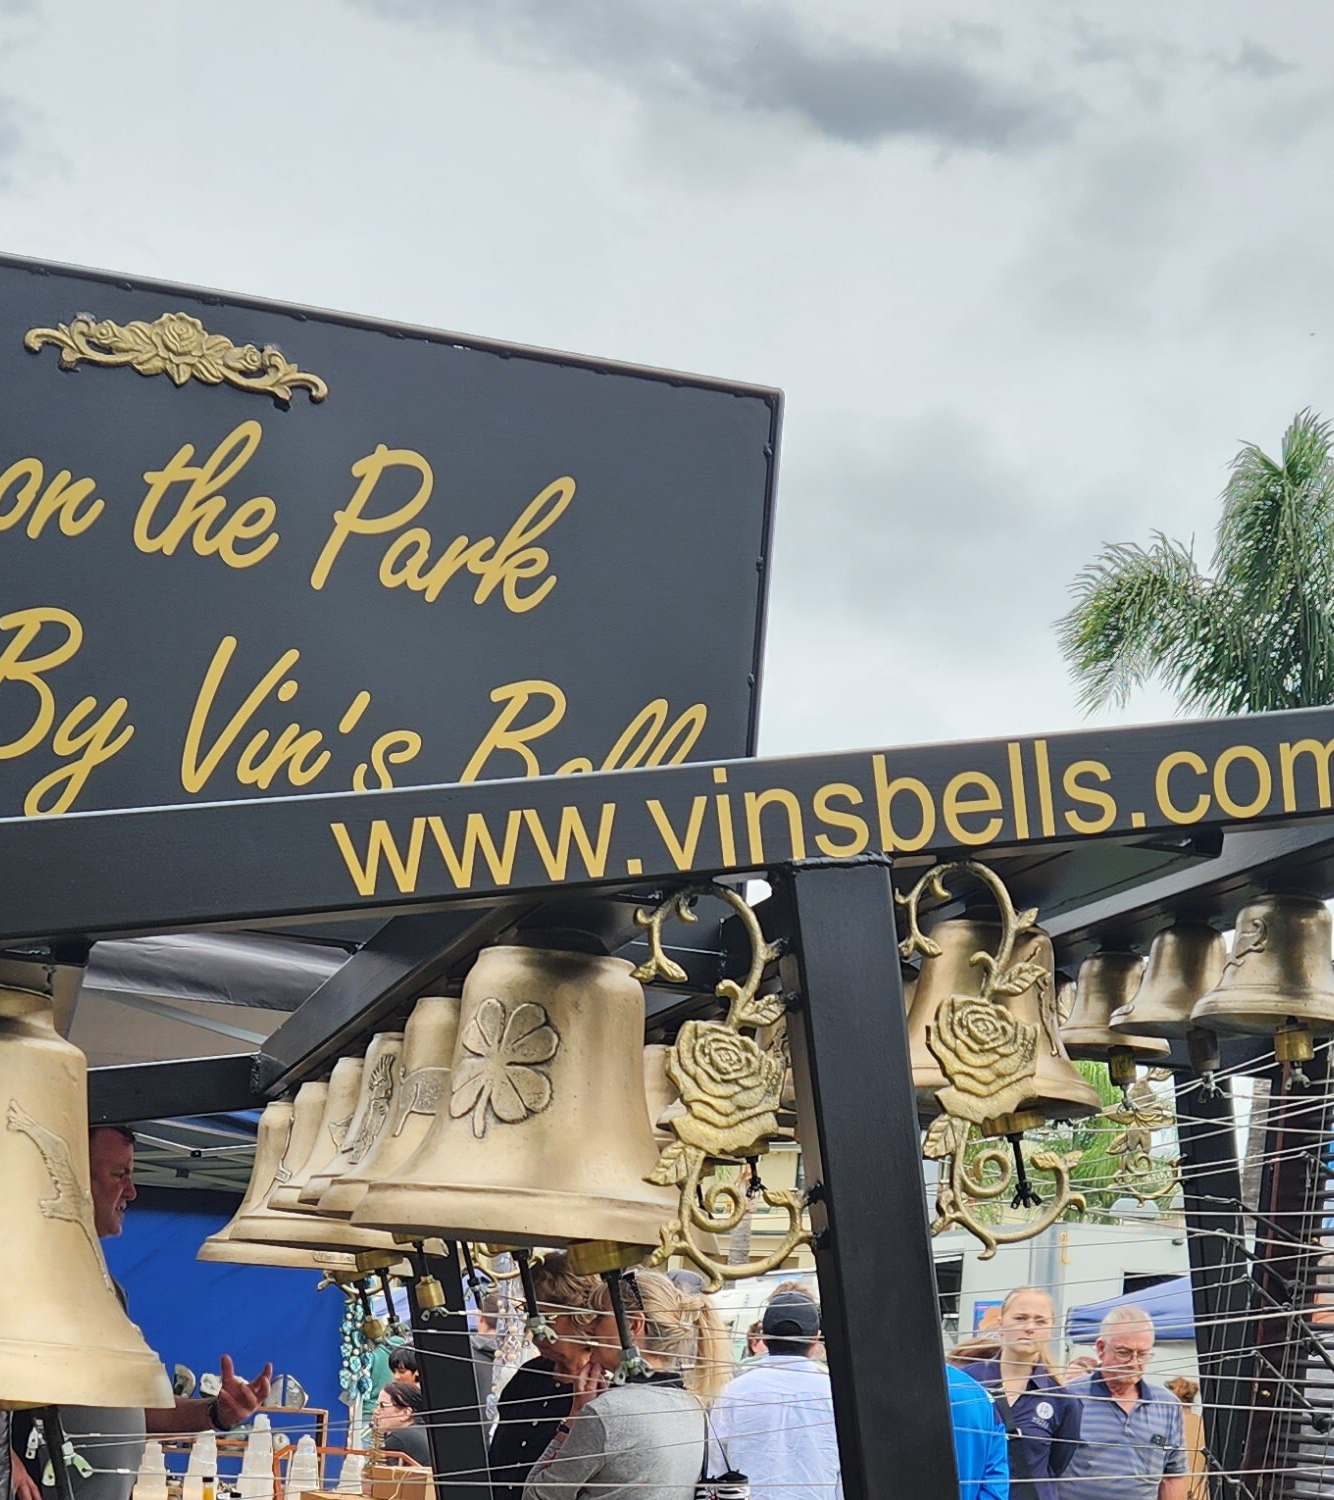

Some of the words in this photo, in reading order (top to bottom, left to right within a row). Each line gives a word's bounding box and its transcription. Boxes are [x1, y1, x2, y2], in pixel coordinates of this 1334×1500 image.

[134, 421, 278, 570] the
[311, 446, 575, 613] Park
[181, 636, 422, 792] Vin's
[459, 680, 707, 785] Bll
